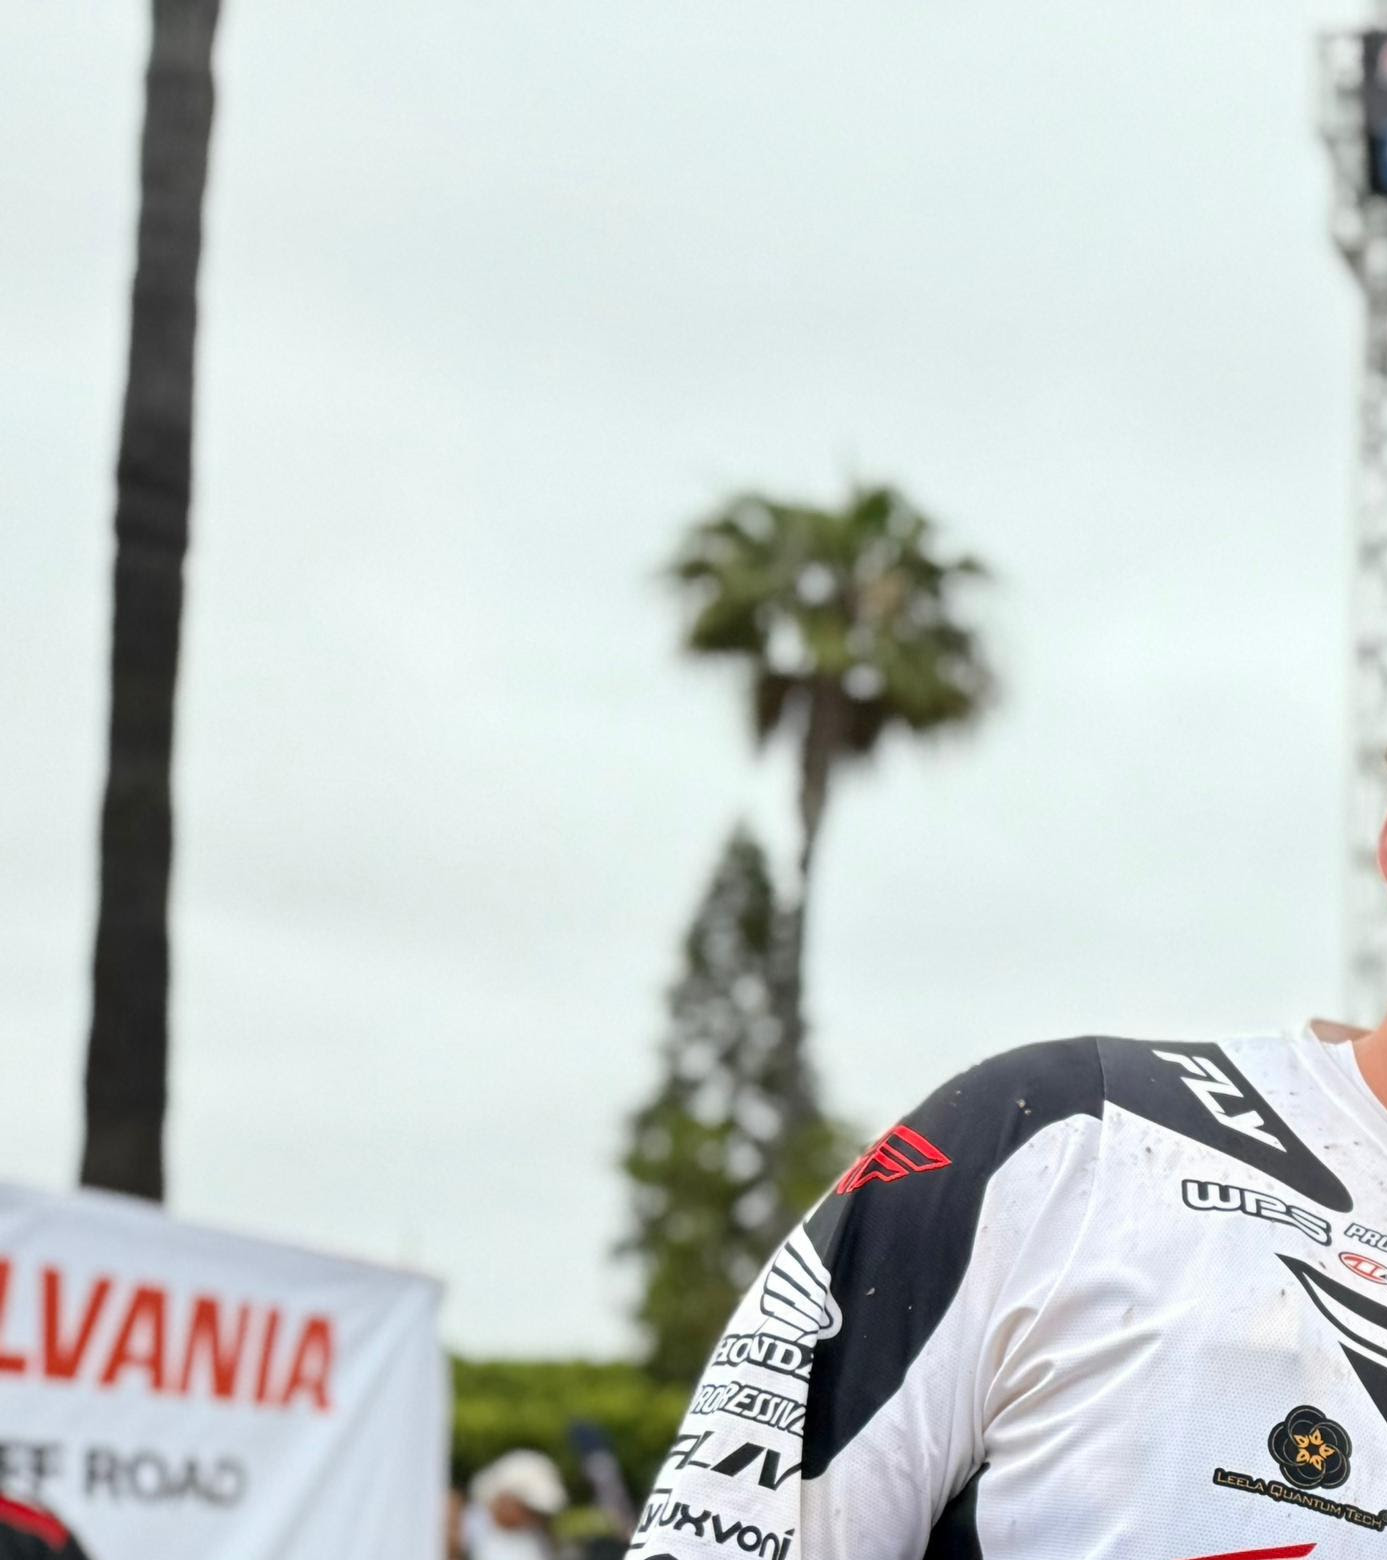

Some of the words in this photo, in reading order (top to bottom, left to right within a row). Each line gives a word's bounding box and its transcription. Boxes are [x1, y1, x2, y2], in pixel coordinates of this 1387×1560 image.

[1181, 1178, 1332, 1247] WPS
[1216, 1470, 1265, 1493] LEELA
[1269, 1483, 1343, 1516] QUANTUM
[1345, 1506, 1383, 1530] TECH
